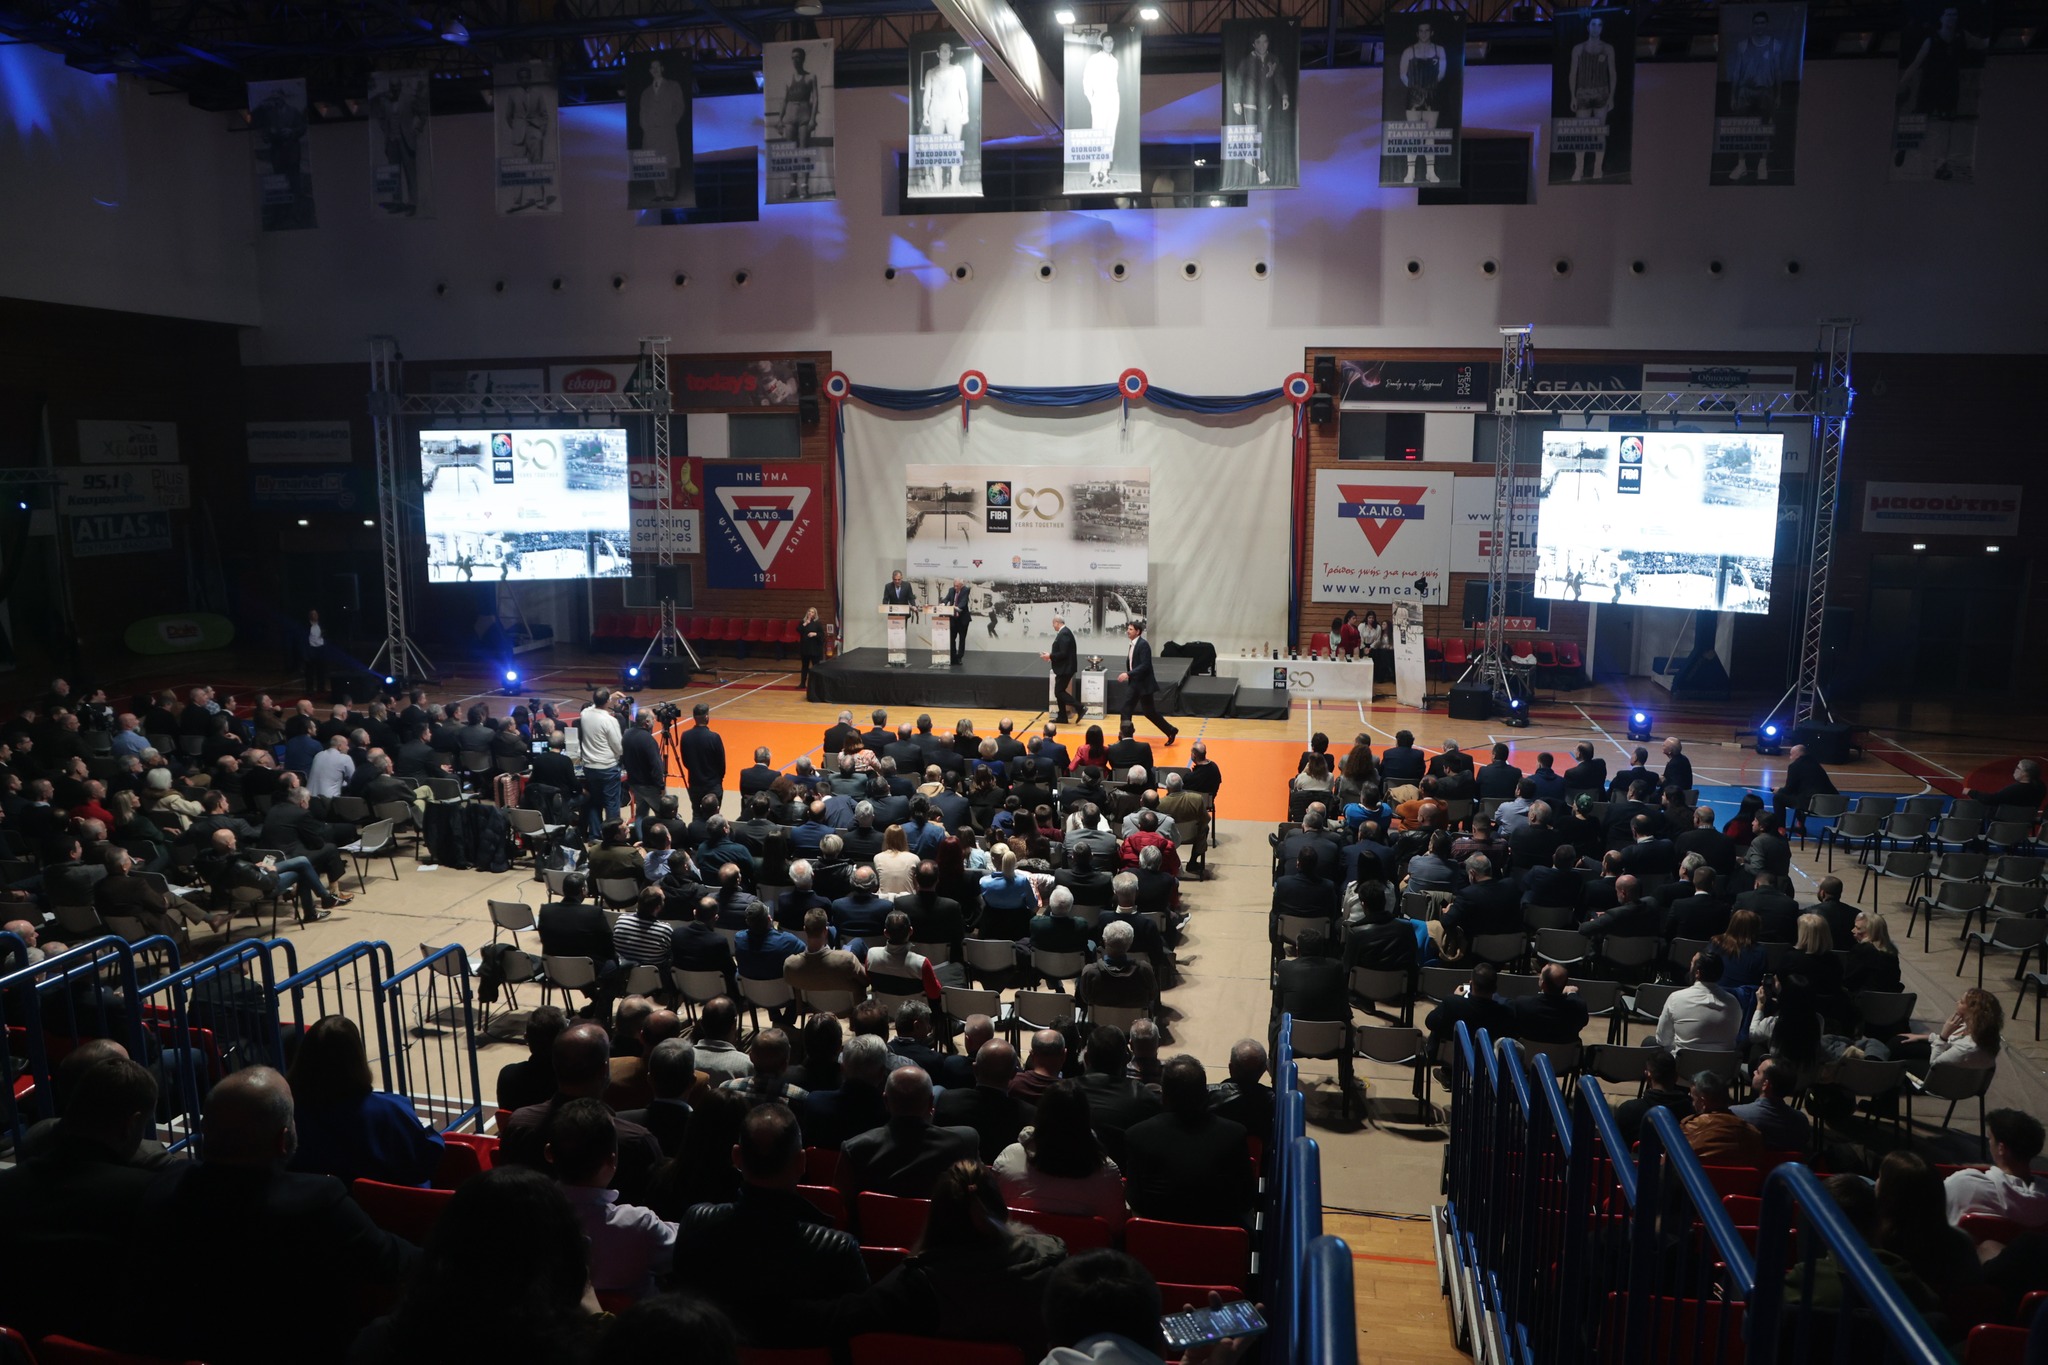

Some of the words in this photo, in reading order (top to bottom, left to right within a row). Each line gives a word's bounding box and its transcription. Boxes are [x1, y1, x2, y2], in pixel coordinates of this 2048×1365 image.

[915, 150, 958, 158] THEODOROS
[1071, 153, 1110, 161] TRONTZOS
[915, 157, 961, 165] RODOPOULOS
[687, 372, 758, 395] today's
[1464, 366, 1472, 395] CREAM
[736, 472, 788, 481] ΠΝΕΥΜΑ
[746, 511, 781, 520] Χ.Α.Ν.Θ.
[990, 511, 1008, 520] FIBA
[1358, 505, 1406, 517] Χ.Α.Ν.Θ.
[76, 514, 151, 542] ATLAS
[636, 515, 691, 531] catering
[719, 517, 742, 553] ΨΥΧΗ
[786, 518, 810, 553] ΣΩΜΑ
[753, 573, 777, 582] 1921
[1322, 583, 1437, 599] www.ymca.gr
